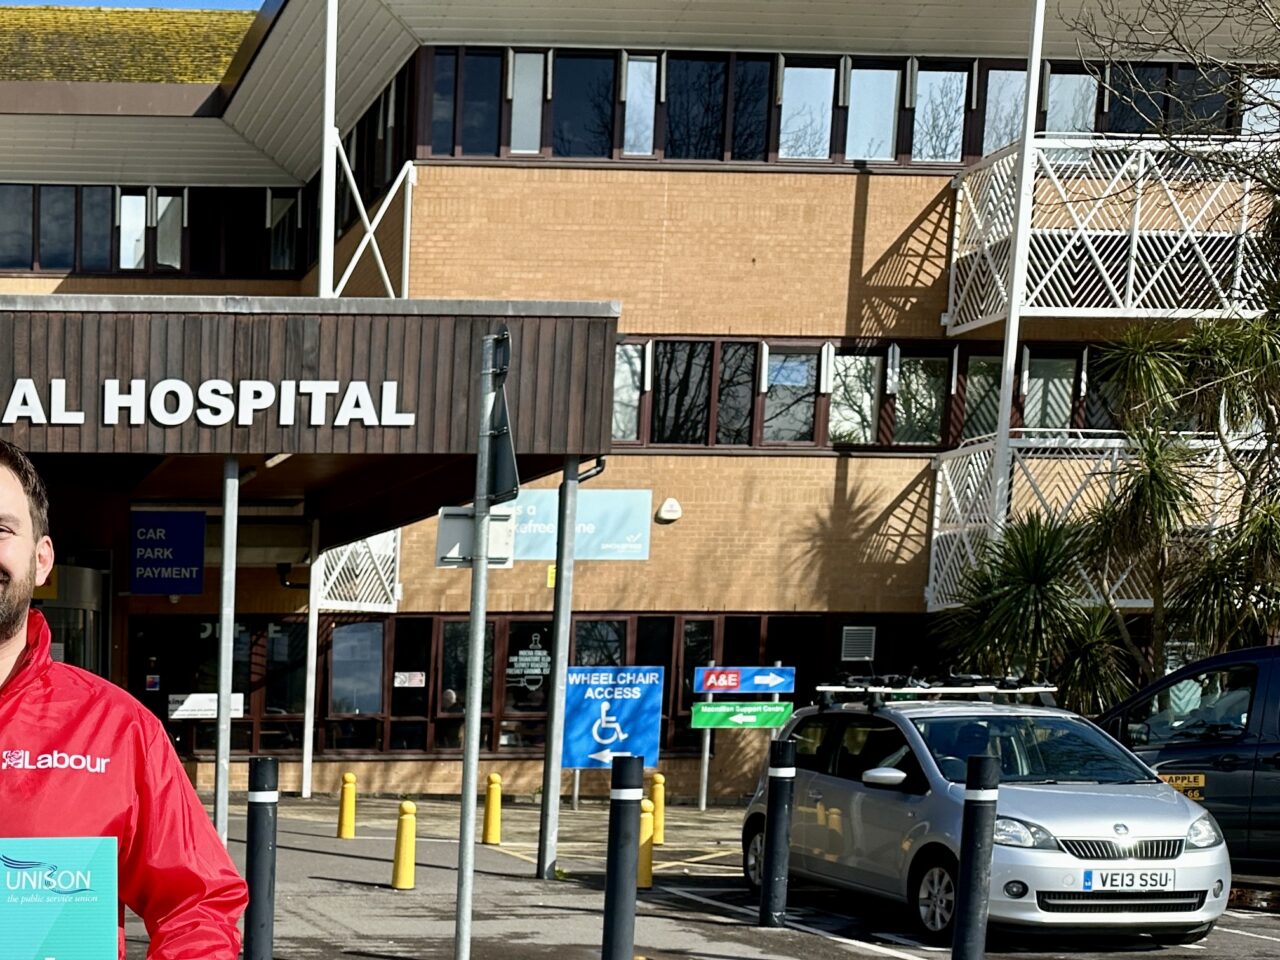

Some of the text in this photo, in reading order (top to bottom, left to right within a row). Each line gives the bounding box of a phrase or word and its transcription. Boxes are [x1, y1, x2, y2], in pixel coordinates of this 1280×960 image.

[103, 378, 417, 428] HOSPITAL
[527, 505, 537, 516] a
[136, 528, 166, 540] CAR
[136, 548, 173, 559] PARK
[136, 567, 199, 578] PAYMENT
[568, 672, 659, 685] WHEELCHAIR
[707, 673, 738, 686] A&E
[584, 687, 641, 699] ACCESS
[736, 705, 762, 714] Support
[24, 750, 111, 773] Labour
[1168, 775, 1200, 783] APPLE
[6, 870, 92, 890] UNISON
[1100, 873, 1168, 887] VE13 SSU
[7, 894, 98, 904] the public service union
